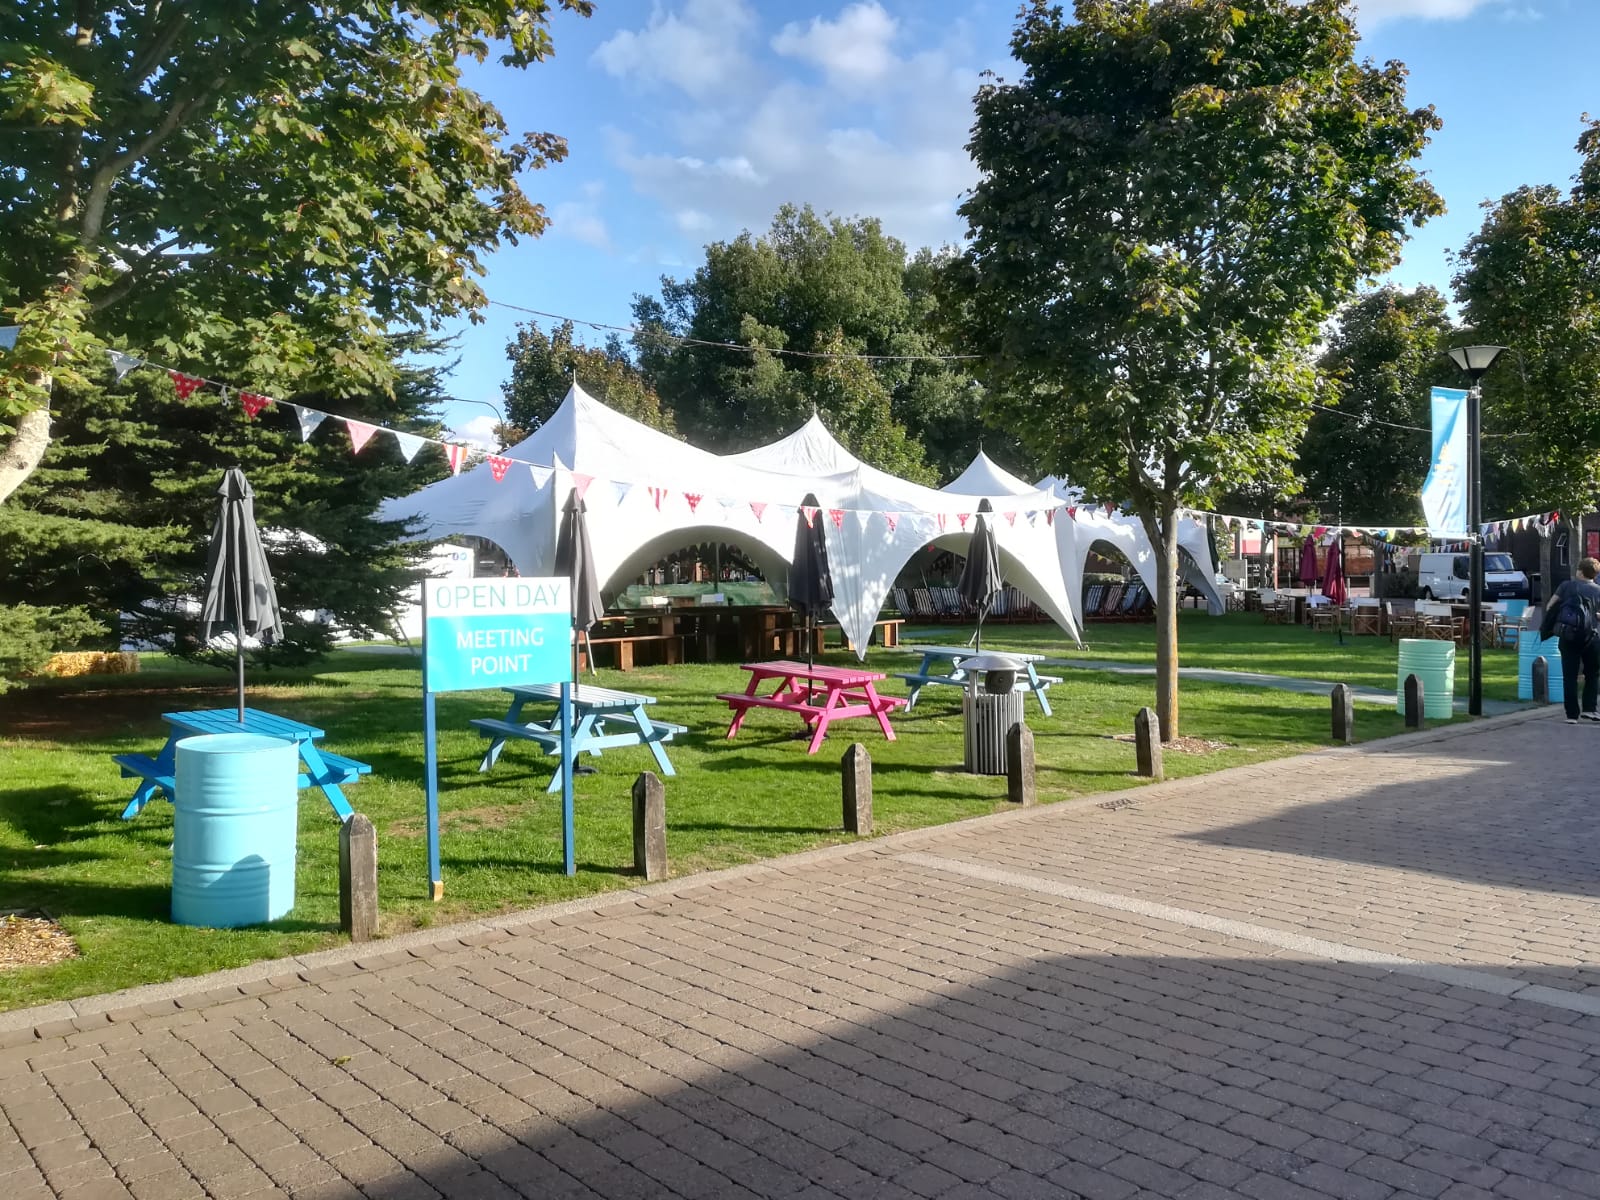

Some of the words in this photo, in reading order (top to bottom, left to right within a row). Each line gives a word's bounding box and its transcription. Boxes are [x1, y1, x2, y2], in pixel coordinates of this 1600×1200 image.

[436, 585, 506, 608] OPEN
[516, 584, 561, 607] DAY
[457, 627, 544, 649] MEETING
[471, 654, 532, 676] POINT
